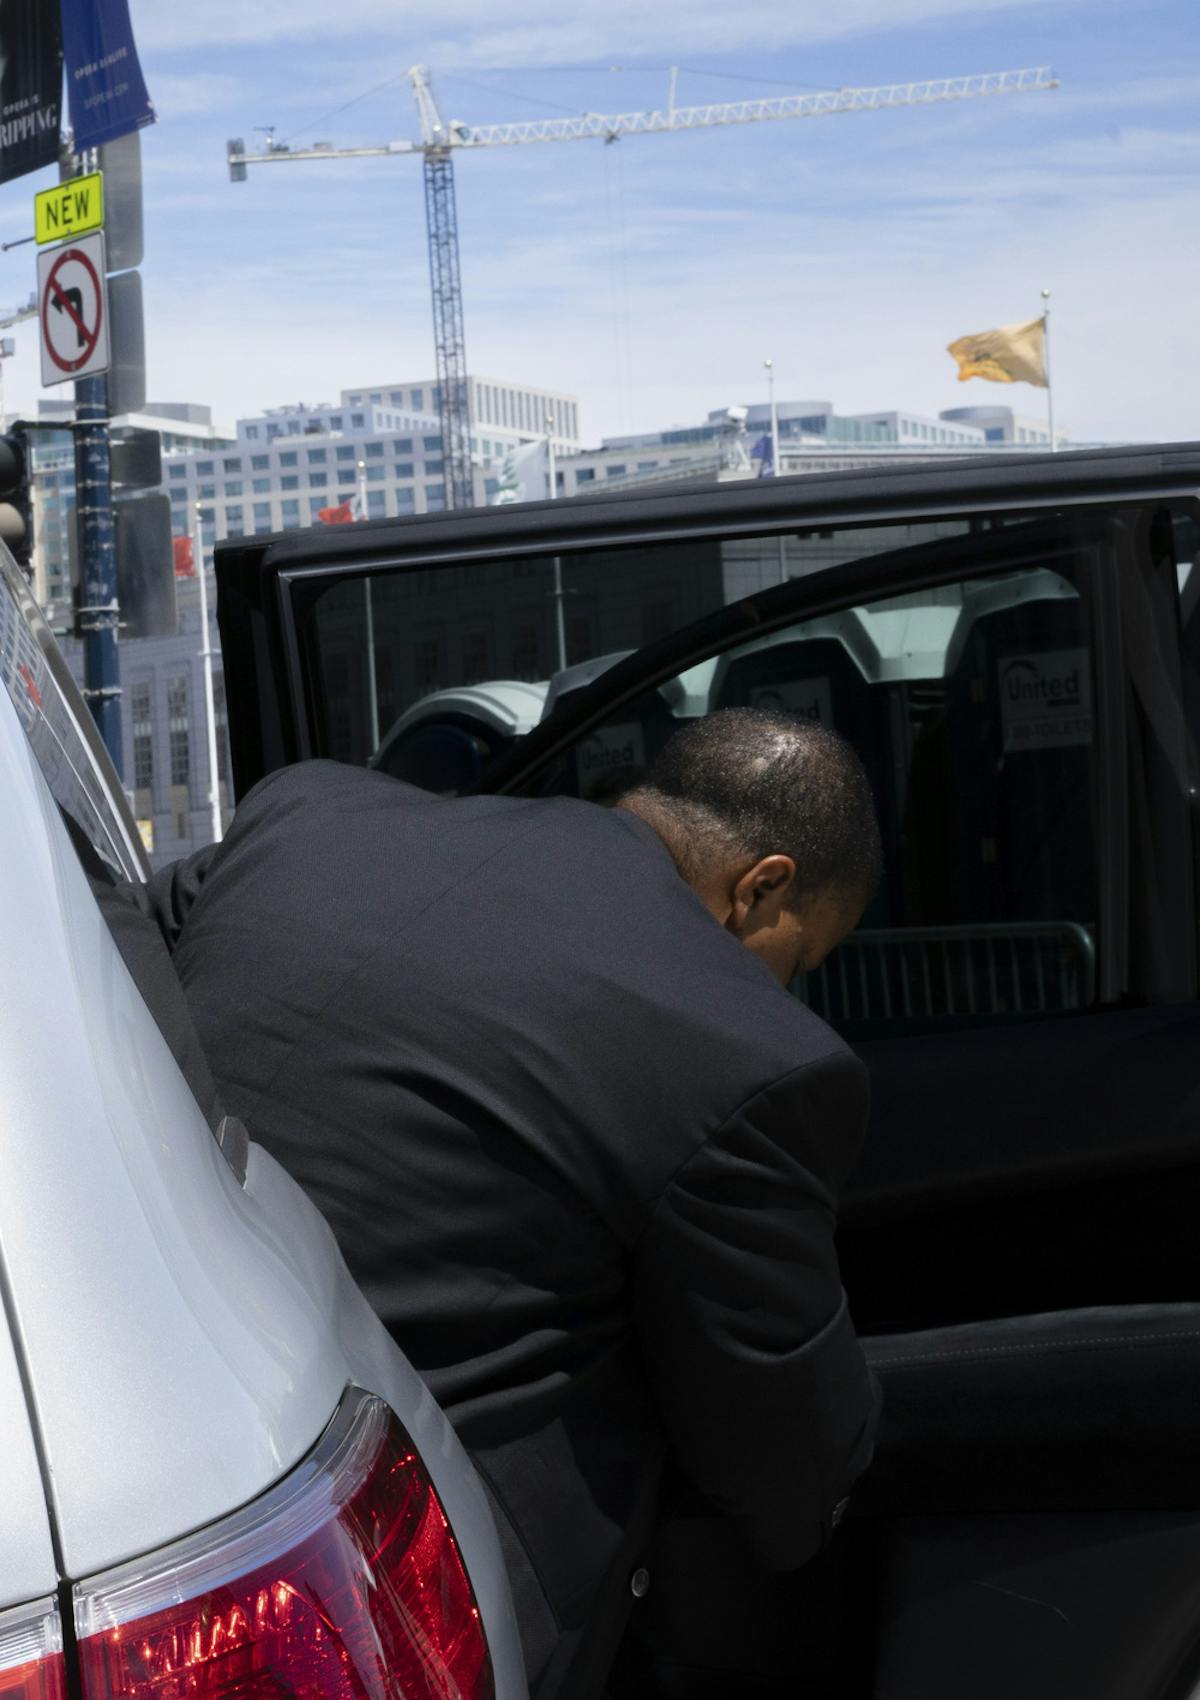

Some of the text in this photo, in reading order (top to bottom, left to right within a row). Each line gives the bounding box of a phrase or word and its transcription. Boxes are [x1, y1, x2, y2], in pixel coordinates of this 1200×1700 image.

[3, 98, 30, 116] OPERA
[46, 189, 90, 231] NEW
[1007, 669, 1079, 701] United
